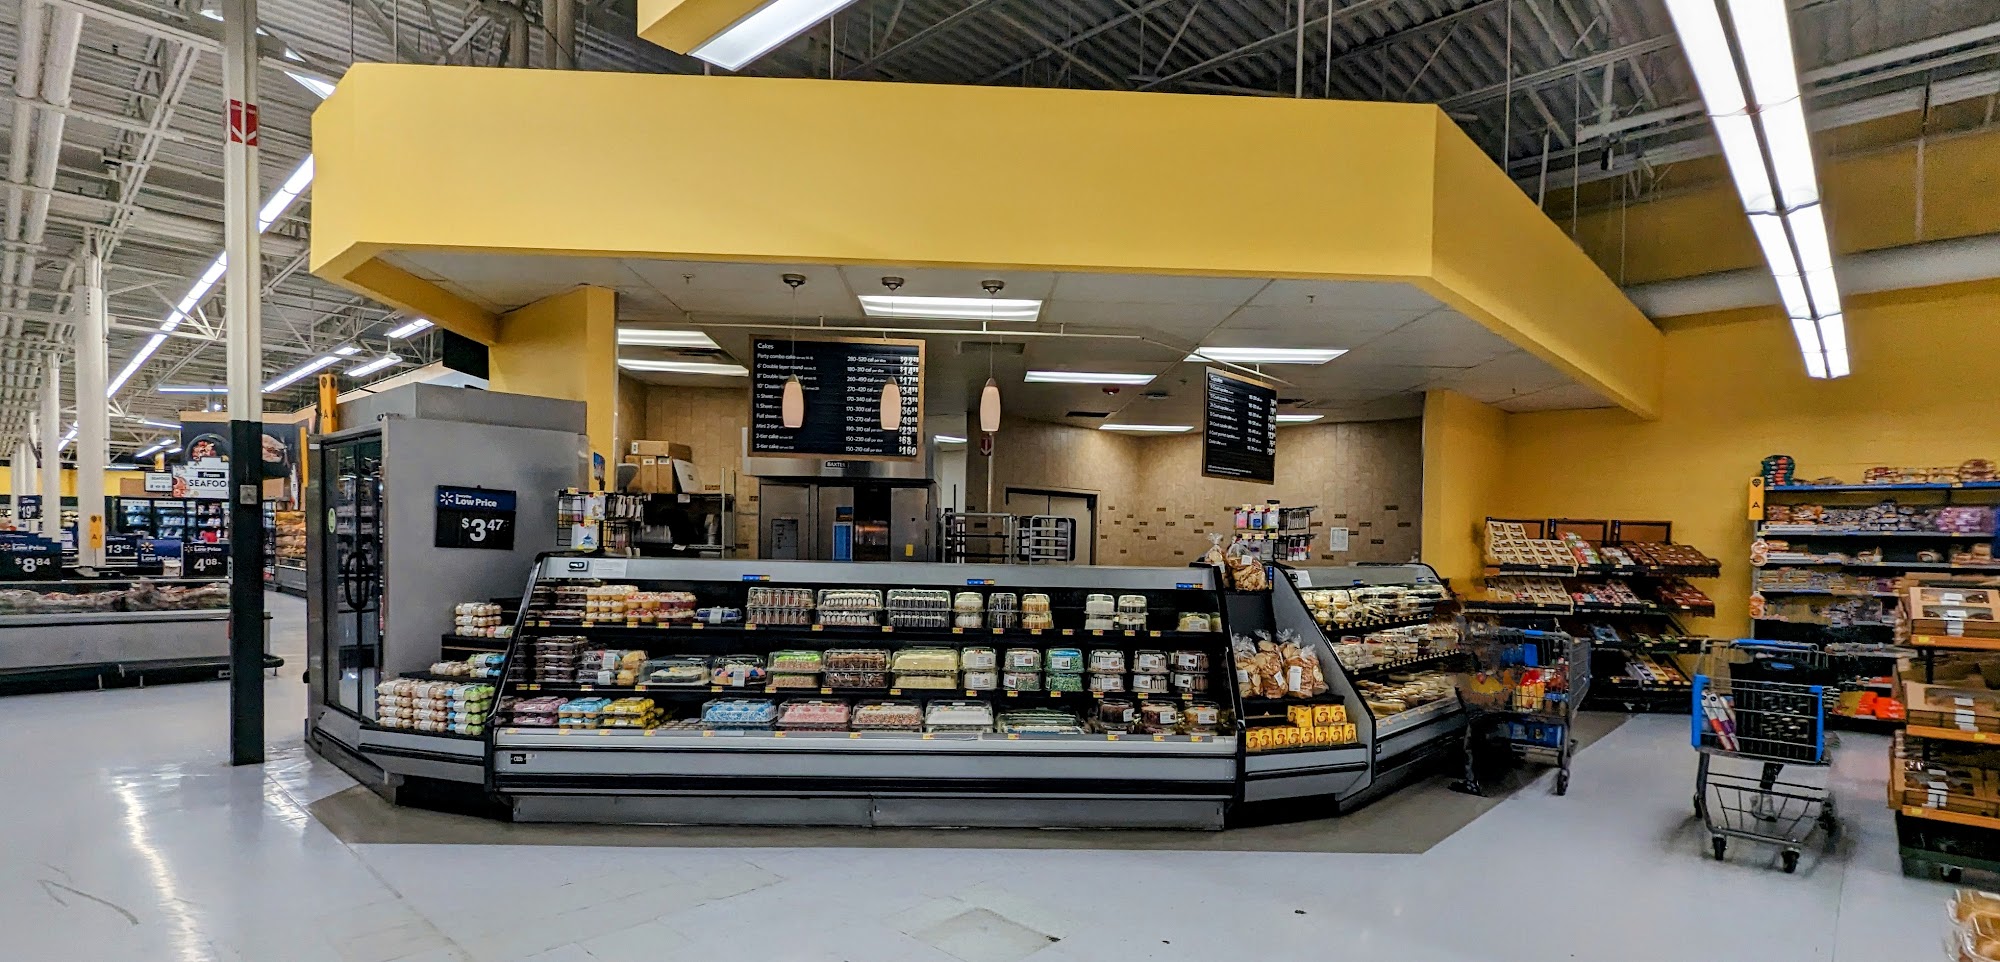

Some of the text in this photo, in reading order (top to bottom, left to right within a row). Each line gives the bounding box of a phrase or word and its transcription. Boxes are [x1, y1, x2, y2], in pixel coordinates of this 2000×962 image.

[899, 436, 912, 445] $68
[899, 446, 917, 455] $160
[456, 497, 497, 507] Low Price
